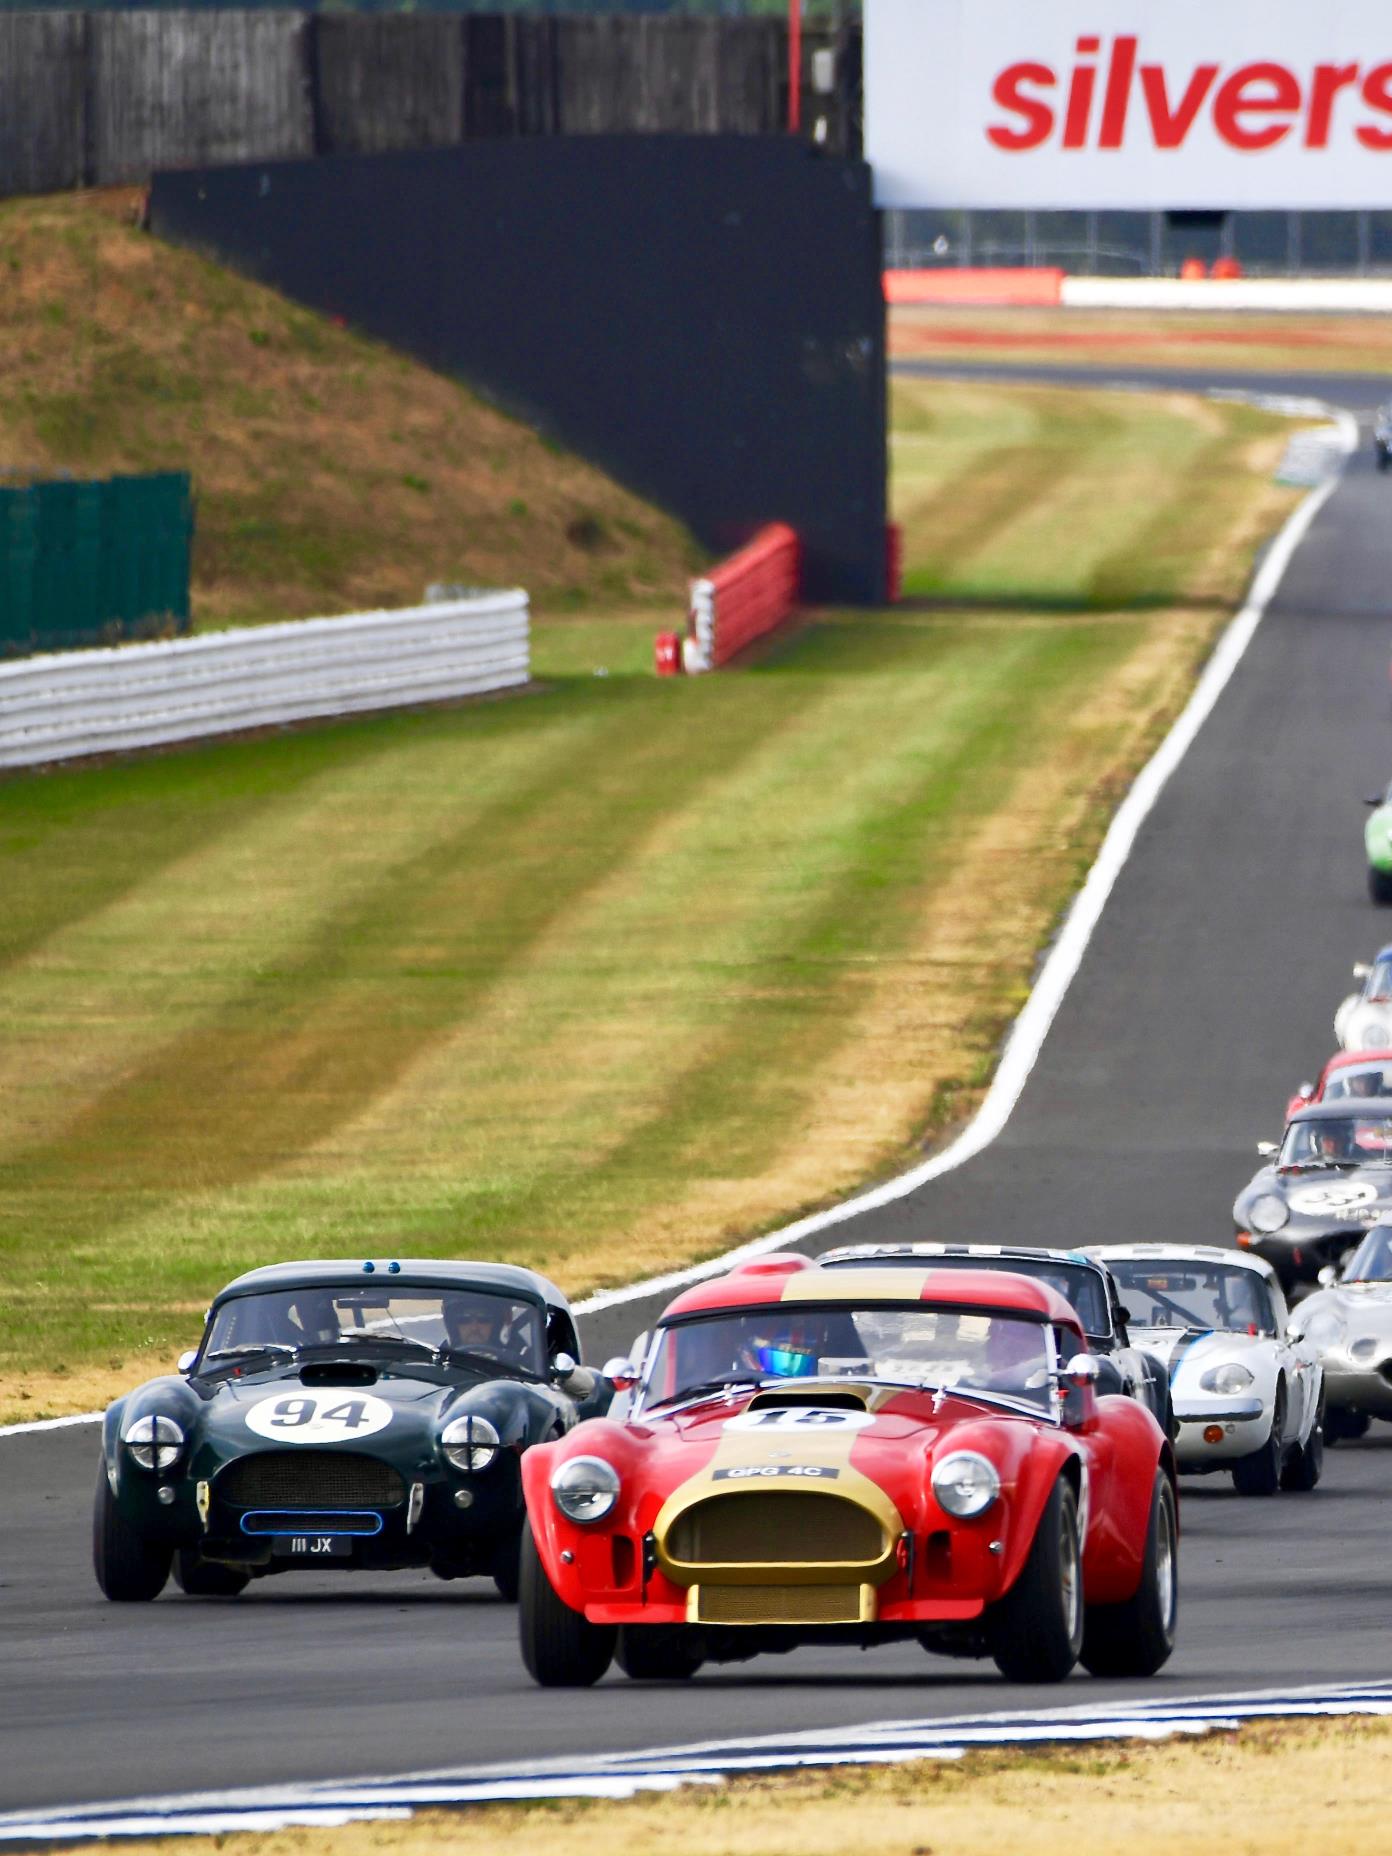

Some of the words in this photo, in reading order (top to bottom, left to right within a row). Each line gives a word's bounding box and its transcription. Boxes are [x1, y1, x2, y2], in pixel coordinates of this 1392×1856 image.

[270, 1399, 370, 1428] 94
[751, 1410, 853, 1426] 15
[310, 1538, 331, 1552] JX
